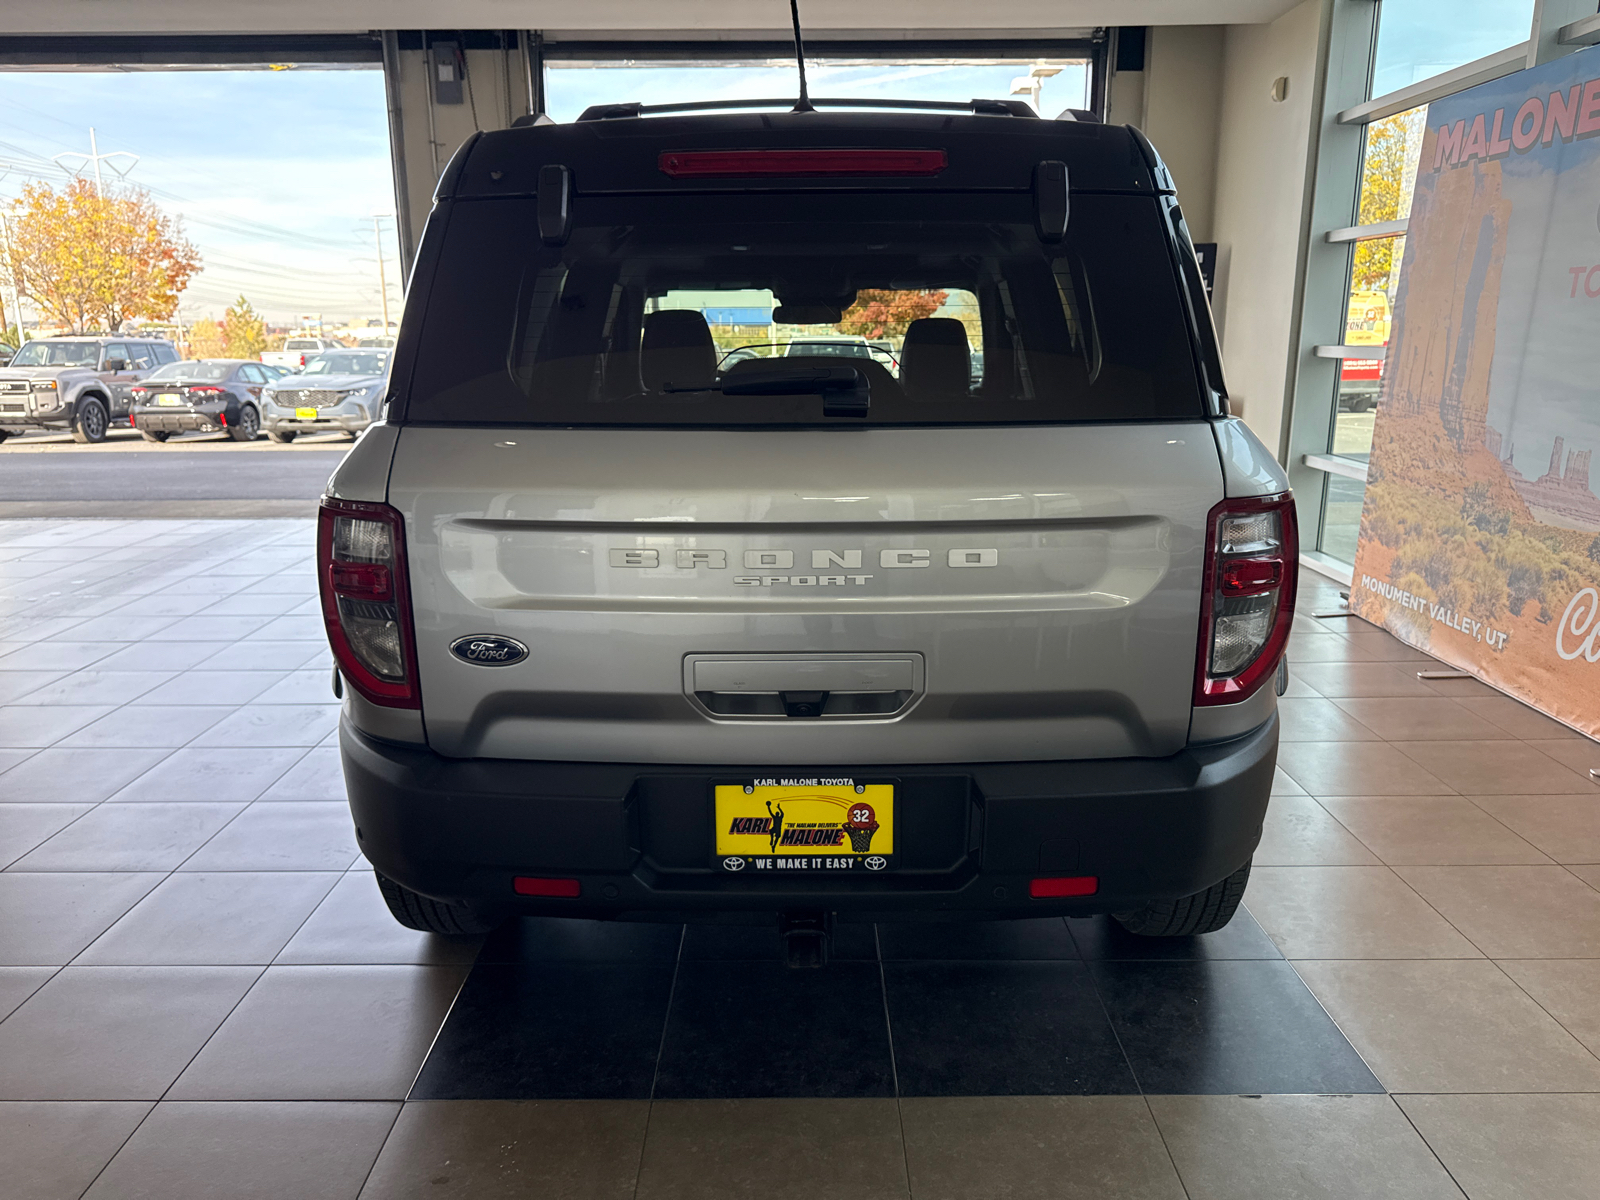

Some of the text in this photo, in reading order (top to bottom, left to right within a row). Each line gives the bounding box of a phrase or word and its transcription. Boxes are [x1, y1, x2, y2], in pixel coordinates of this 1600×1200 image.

[1432, 77, 1600, 173] MALONE
[609, 548, 998, 569] BRONCO
[733, 574, 874, 586] SPORT
[1361, 574, 1507, 650] MONUMENT VALLEY, UT
[467, 641, 509, 660] Ford
[820, 778, 854, 786] TOYOTA
[853, 809, 869, 823] 32
[729, 817, 772, 835] KARL
[779, 829, 844, 846] MALONE
[756, 858, 854, 869] WE MAKE IT EASY
